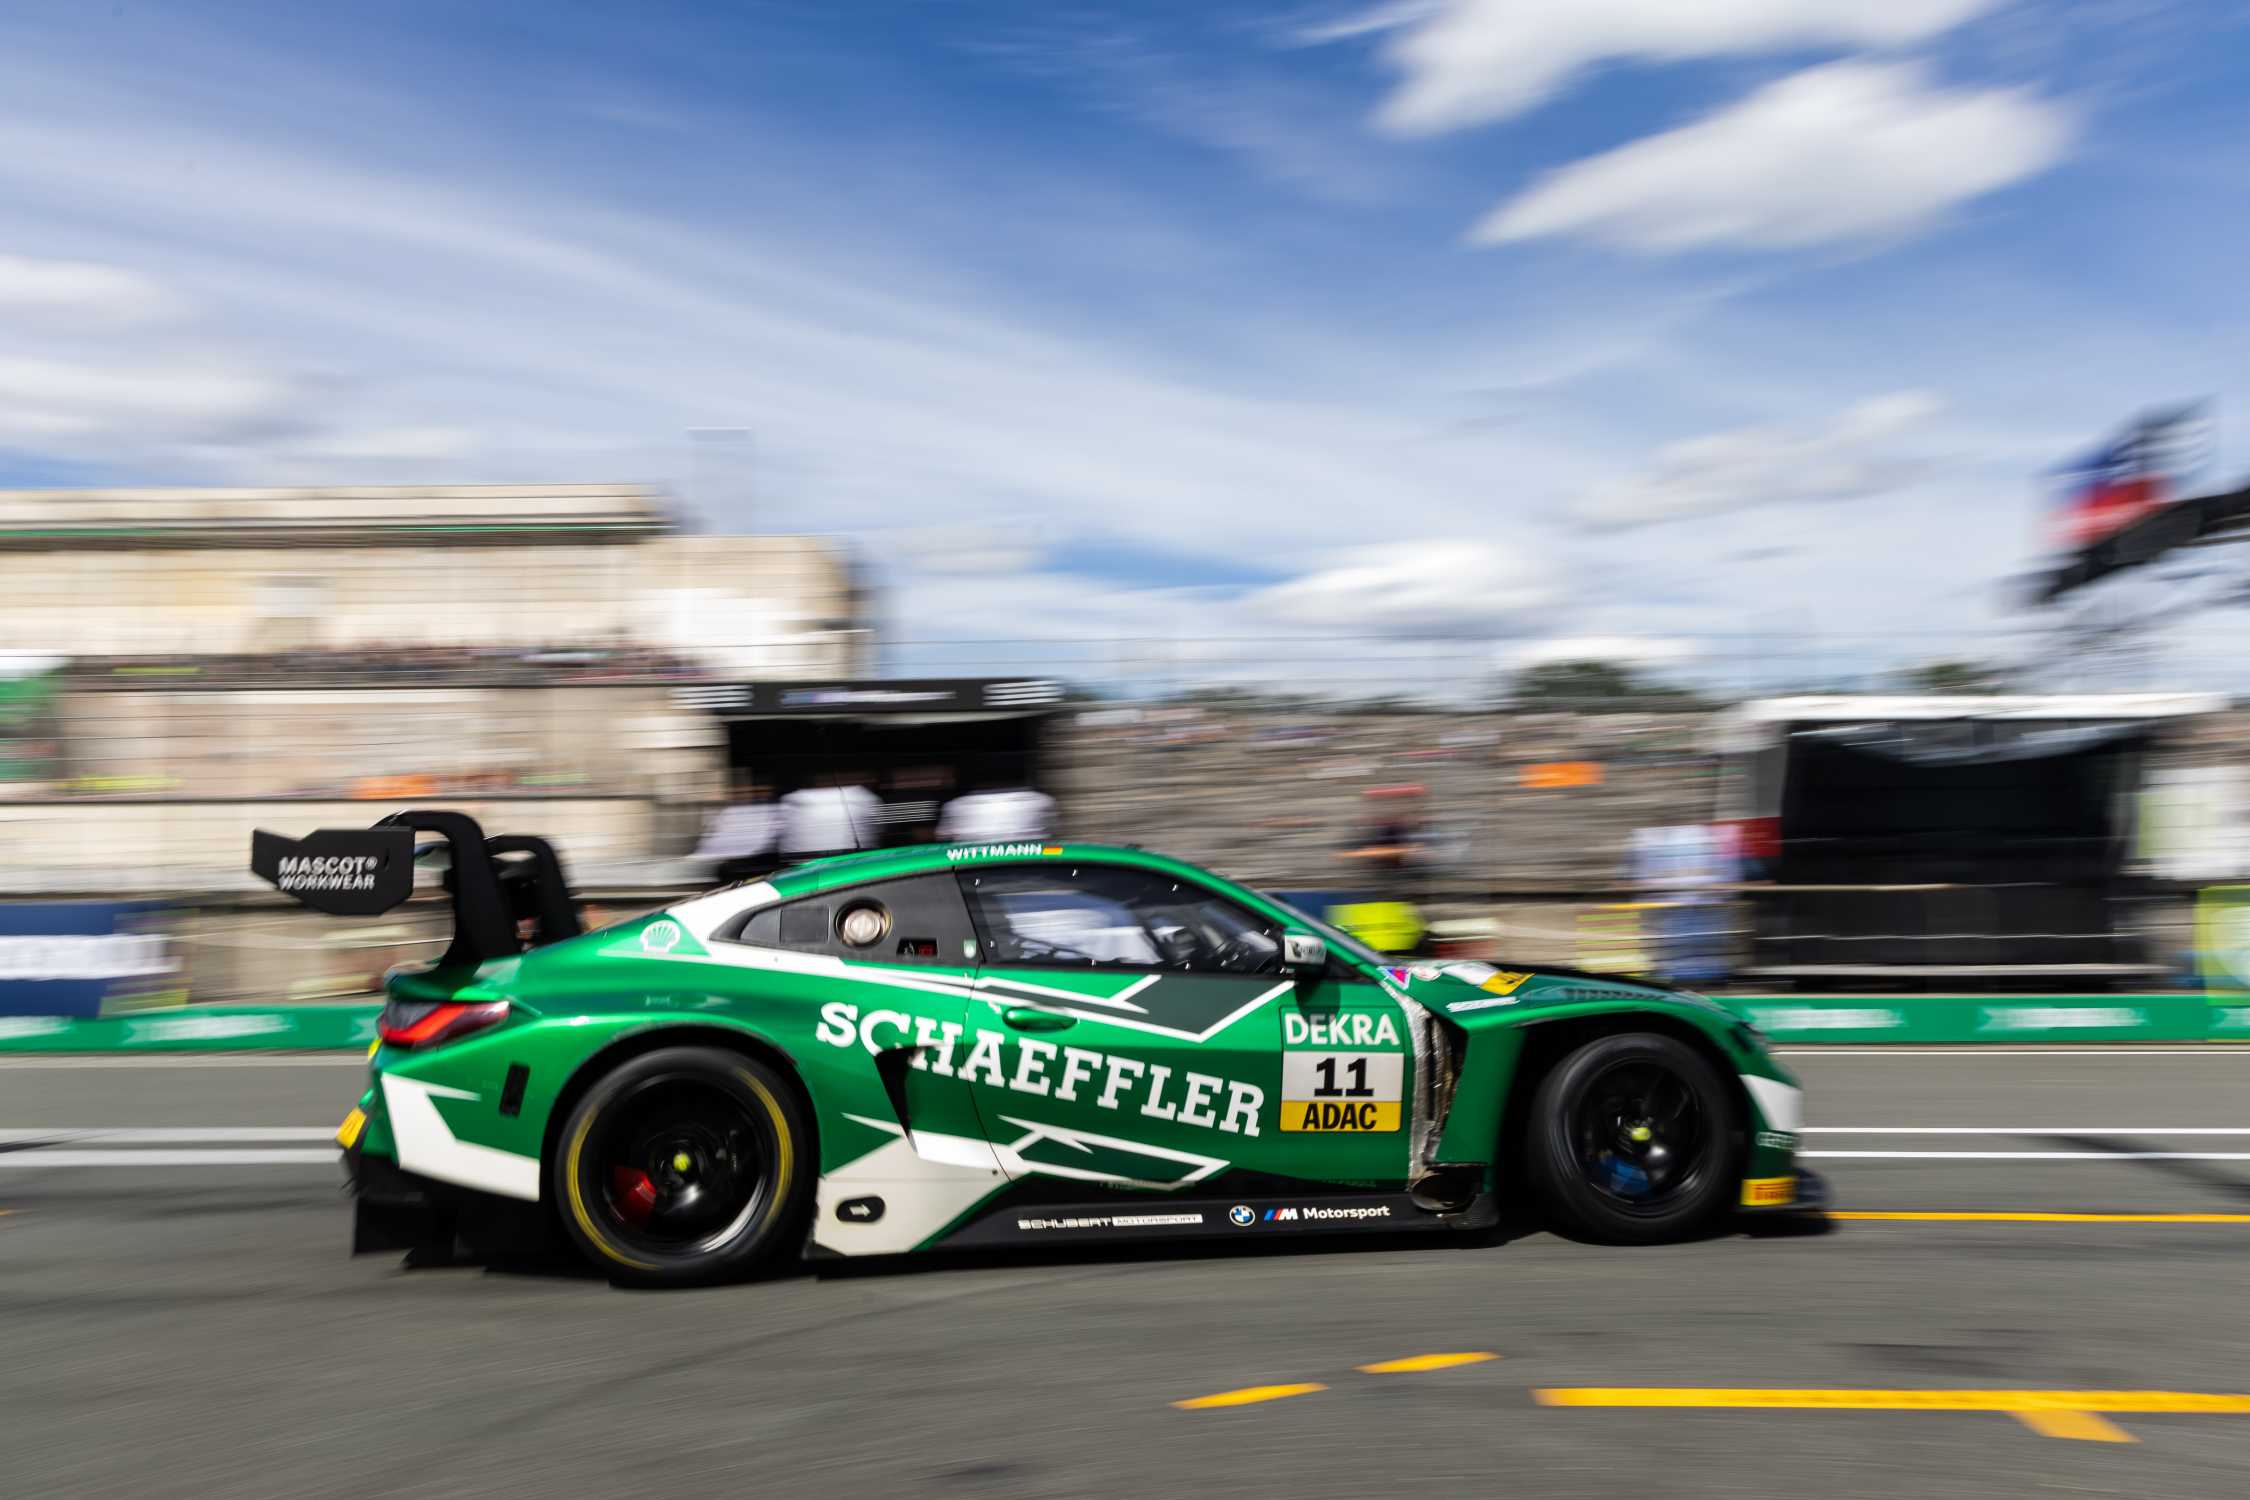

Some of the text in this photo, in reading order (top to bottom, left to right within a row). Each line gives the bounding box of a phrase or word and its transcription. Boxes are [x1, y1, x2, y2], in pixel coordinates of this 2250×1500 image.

[946, 843, 1042, 861] WITTMANN
[278, 874, 375, 890] WORKWEAR
[1284, 1013, 1400, 1045] DEKRA
[815, 1001, 1265, 1137] SCHAEFFLER
[1314, 1057, 1375, 1097] 11
[1302, 1103, 1378, 1130] ADAC
[1018, 1217, 1112, 1230] SCHUBERT
[1303, 1206, 1391, 1220] Motorsport
